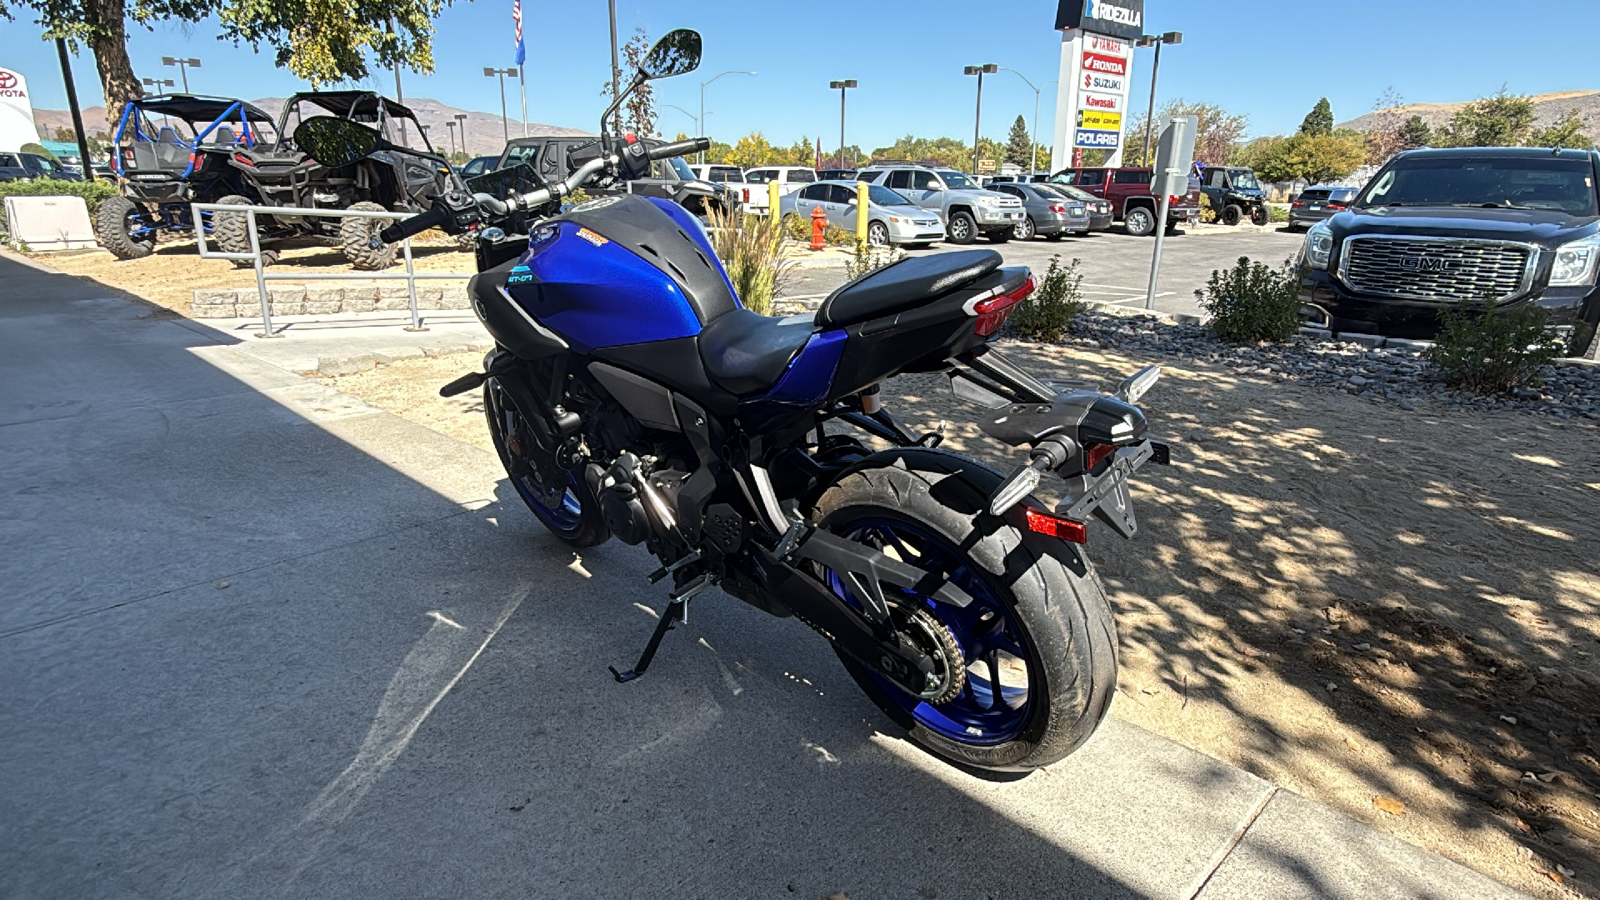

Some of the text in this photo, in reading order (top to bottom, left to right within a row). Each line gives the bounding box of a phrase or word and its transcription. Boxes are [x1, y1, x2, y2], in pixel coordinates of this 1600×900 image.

[1099, 37, 1121, 53] YAMAHA
[1092, 60, 1124, 73] HONDA
[1093, 77, 1121, 90] SUZUKI
[1085, 95, 1116, 108] Kawasaki
[1077, 132, 1118, 145] POLARIS
[1399, 256, 1463, 274] GMC
